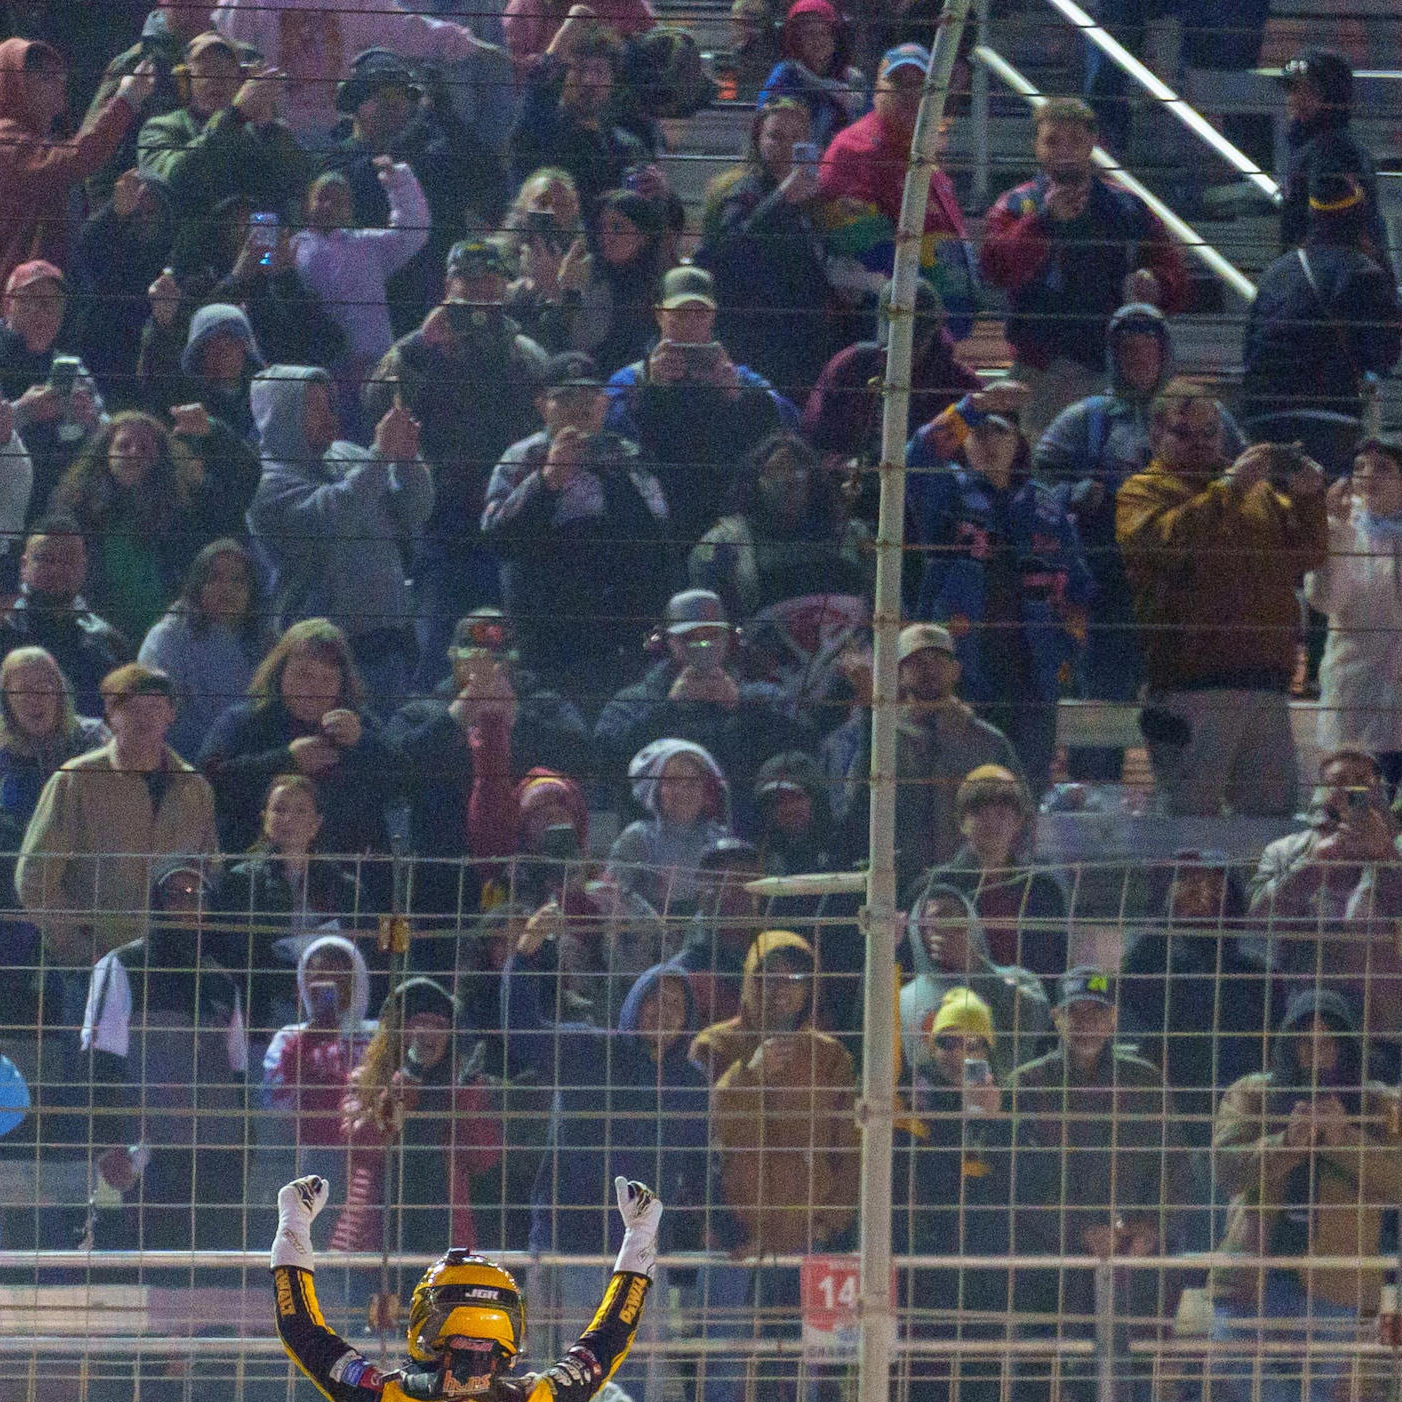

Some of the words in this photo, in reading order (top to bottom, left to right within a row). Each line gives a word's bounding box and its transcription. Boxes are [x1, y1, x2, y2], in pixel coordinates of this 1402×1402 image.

[465, 1288, 499, 1300] JGR
[619, 1276, 648, 1325] DeWAL
[819, 1275, 855, 1311] 14
